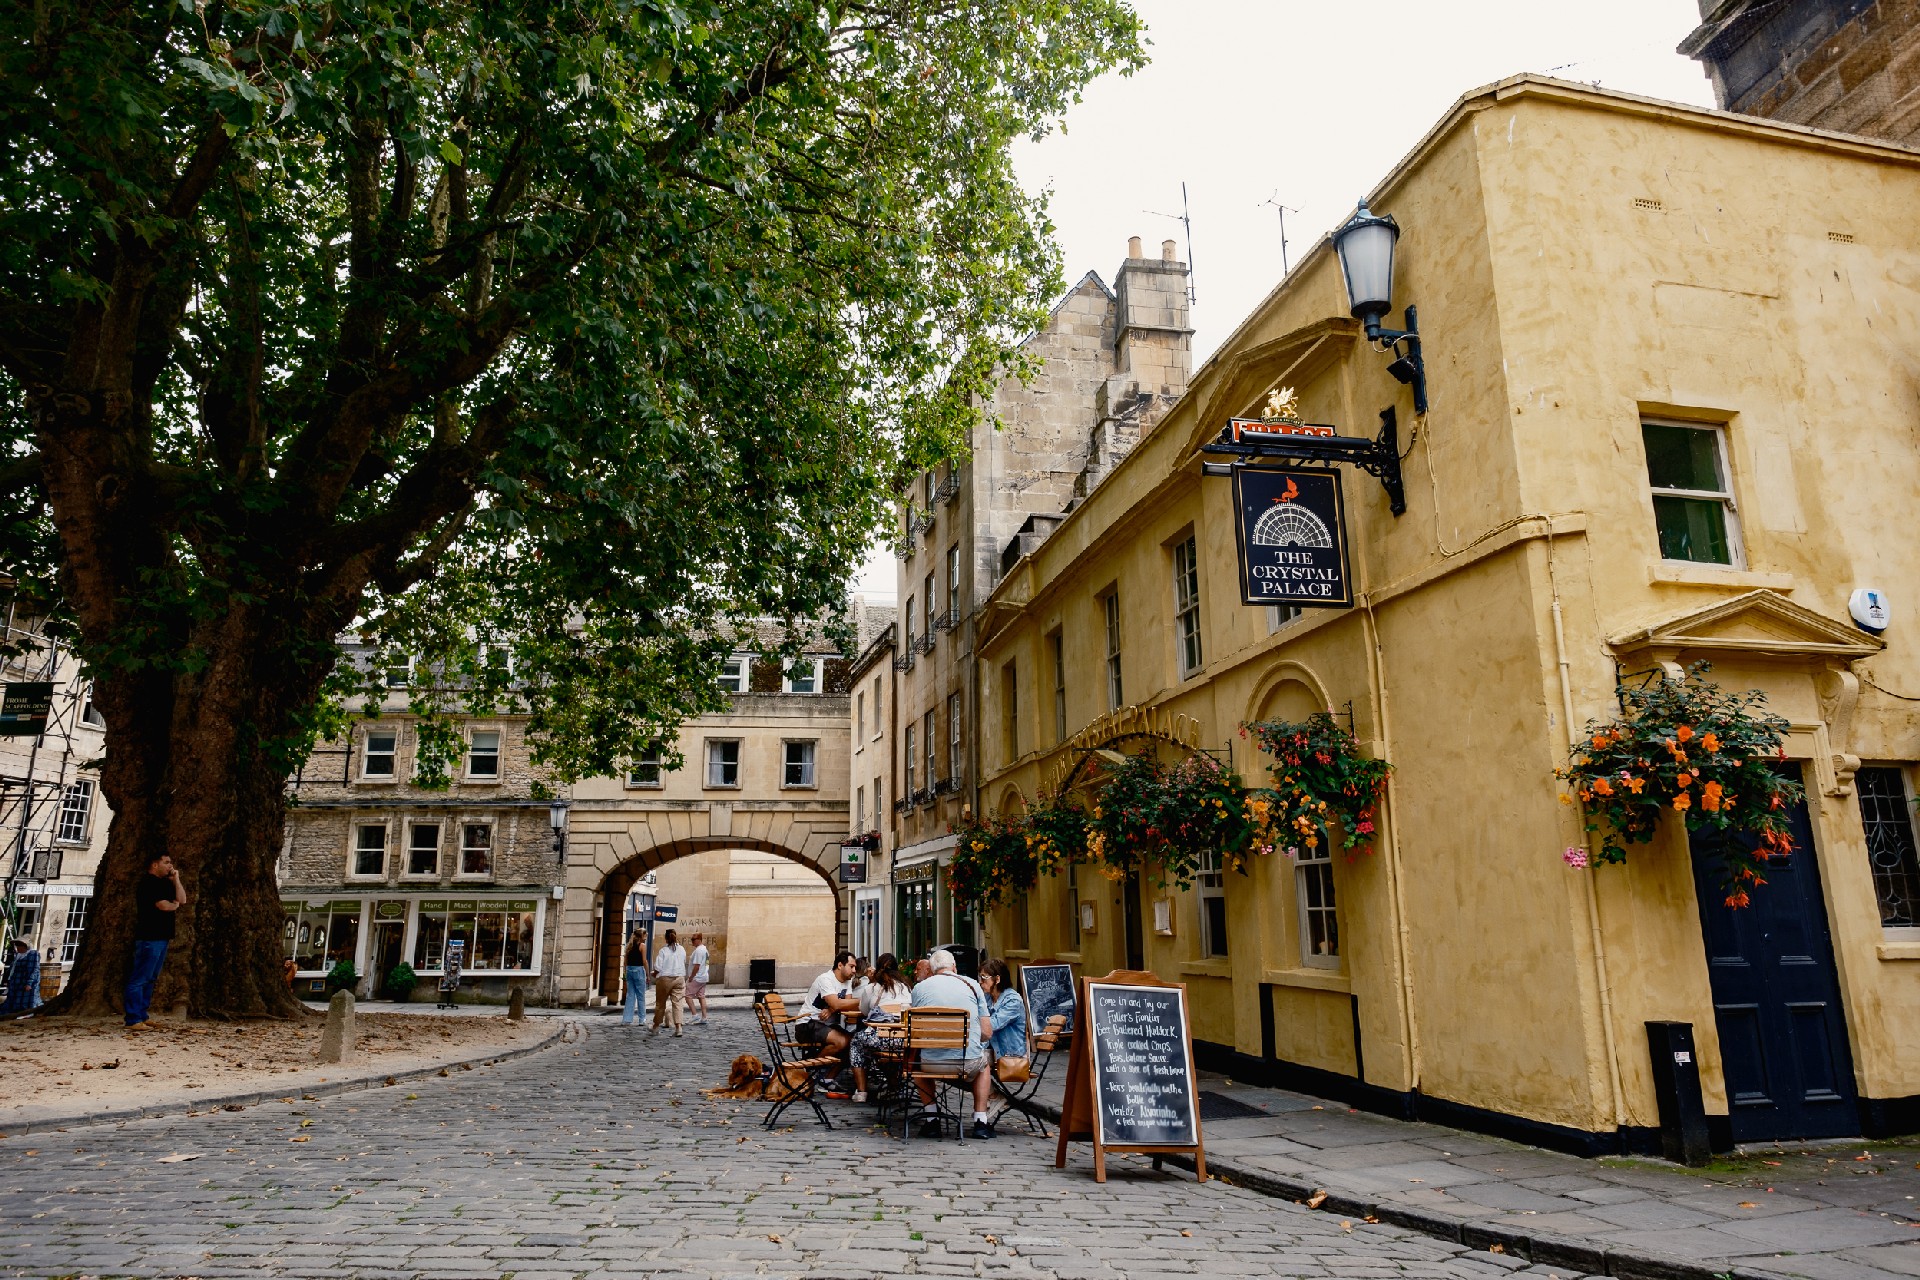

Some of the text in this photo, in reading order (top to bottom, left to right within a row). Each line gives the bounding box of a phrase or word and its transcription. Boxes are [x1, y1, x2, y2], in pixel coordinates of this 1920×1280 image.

[1275, 551, 1313, 565] THE
[1252, 565, 1339, 581] CRYSTAL
[1261, 581, 1332, 597] PALACE
[1129, 704, 1200, 751] PALACE
[480, 901, 507, 909] Wooden
[680, 918, 713, 927] MARKS
[1099, 996, 1116, 1007] Come
[1118, 996, 1127, 1007] in
[1128, 999, 1141, 1008] and
[1156, 1001, 1170, 1009] our
[1112, 1024, 1143, 1036] Battered
[1105, 1064, 1120, 1073] with
